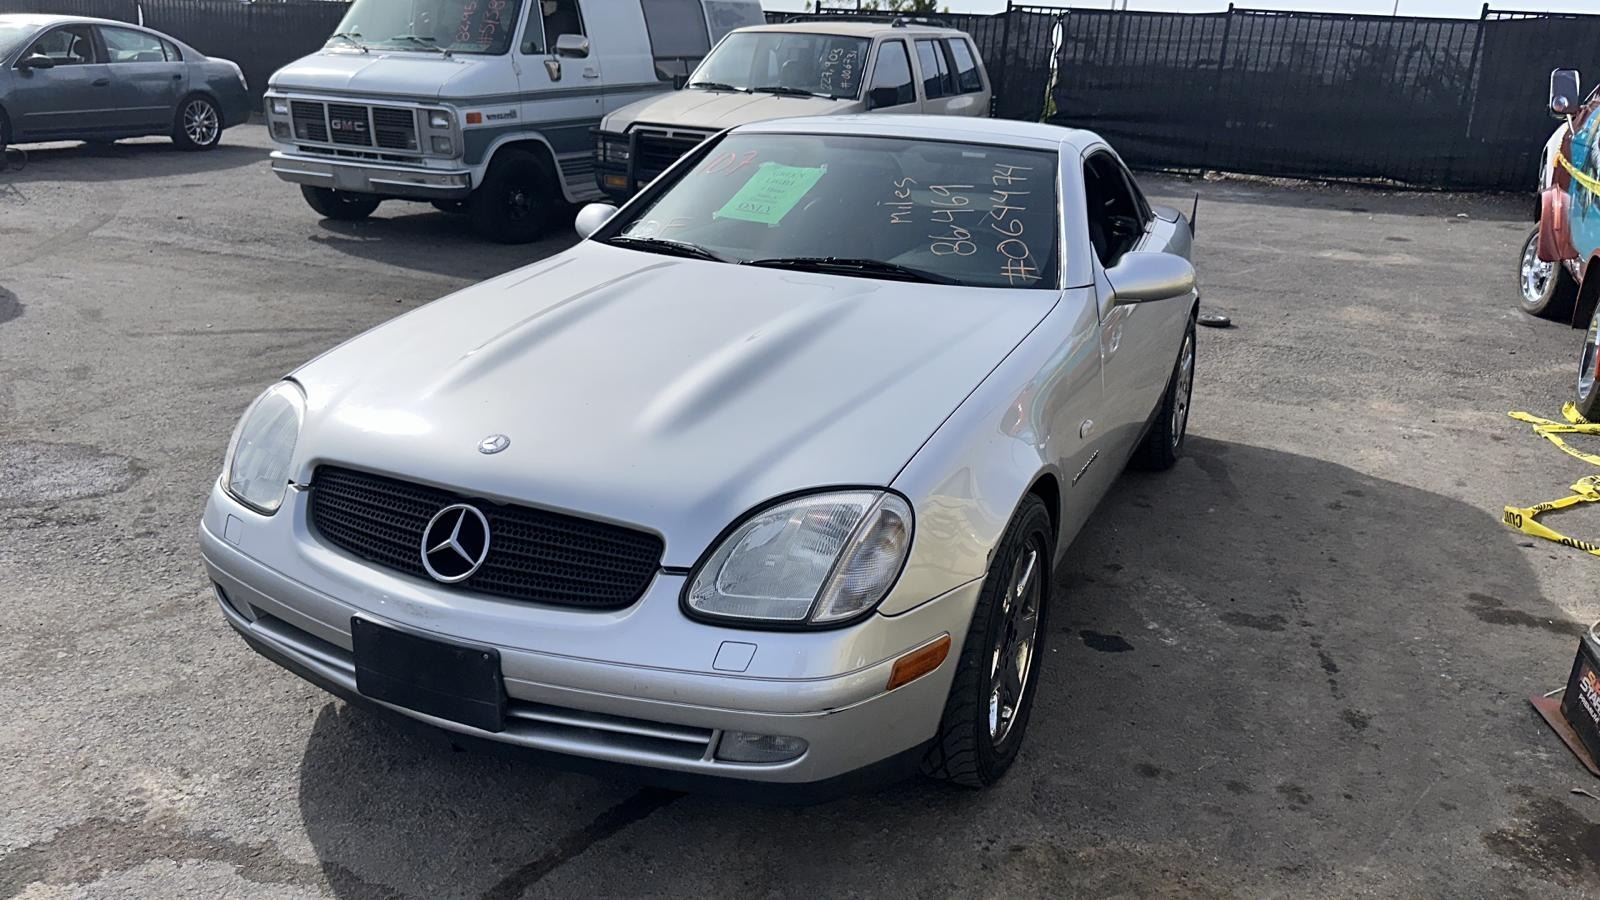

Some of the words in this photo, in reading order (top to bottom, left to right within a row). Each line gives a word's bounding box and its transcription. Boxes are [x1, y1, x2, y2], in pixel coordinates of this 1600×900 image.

[331, 119, 367, 132] GMC
[738, 202, 771, 213] ONLY
[928, 184, 977, 256] 86469
[989, 163, 1043, 286] #064474
